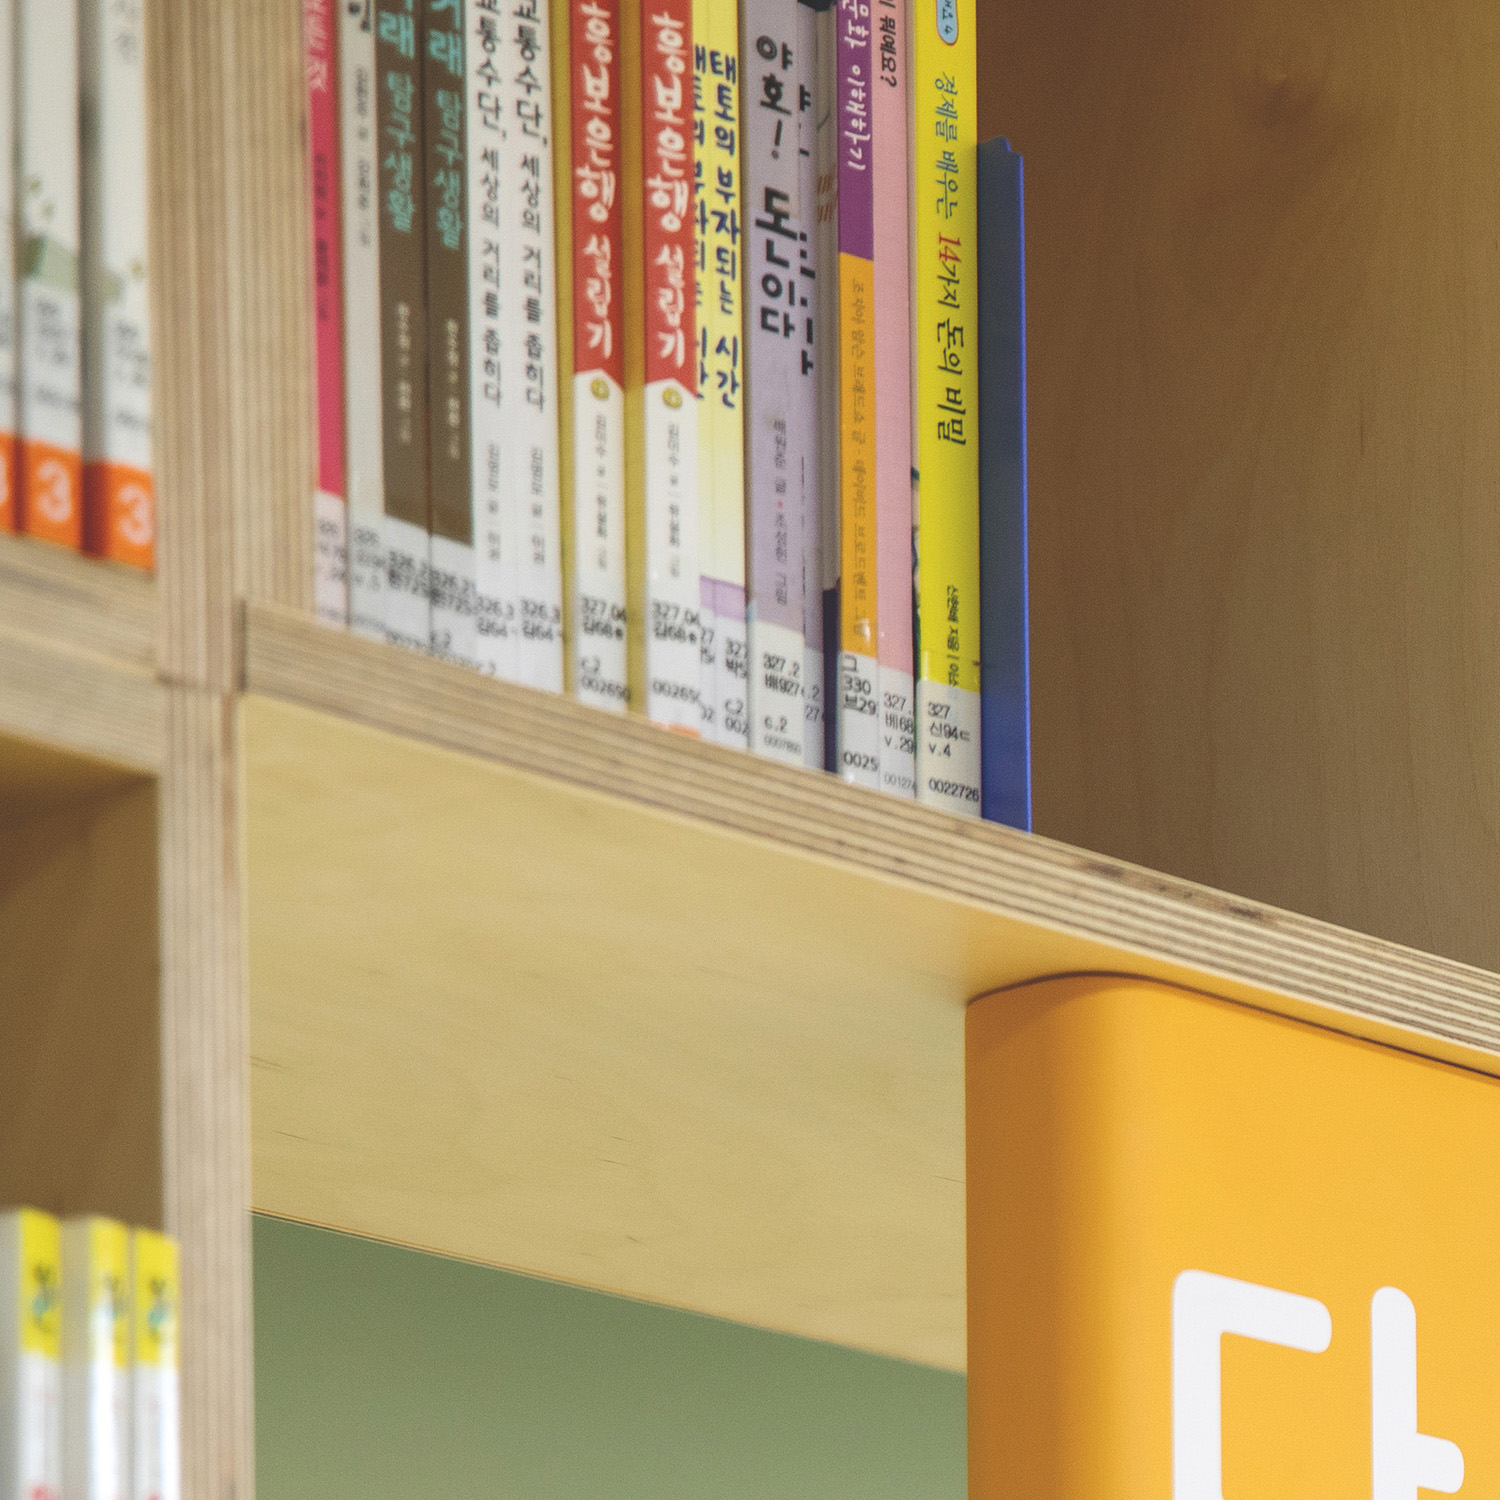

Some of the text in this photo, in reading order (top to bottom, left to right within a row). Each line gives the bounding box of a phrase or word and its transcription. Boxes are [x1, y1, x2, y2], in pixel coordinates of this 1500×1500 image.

[880, 16, 898, 88] 뭐예요?
[844, 64, 872, 171] 이해하기
[480, 147, 499, 228] 세상의
[521, 154, 540, 236] 세상의
[482, 238, 500, 318] 거리를
[523, 244, 543, 325] 거리를
[582, 233, 613, 359] 설립기
[934, 71, 967, 446] 경제를 배우는 14가지 돈의 비밀
[655, 243, 687, 368] 설립기
[484, 326, 501, 408] 좁히다
[525, 331, 544, 413] 좁히다
[714, 335, 740, 409] 시간
[38, 459, 72, 523] 3
[116, 482, 154, 545] 3
[843, 675, 872, 696] 330
[927, 701, 951, 720] 327
[928, 743, 952, 758] v.4
[928, 778, 981, 804] 0022726
